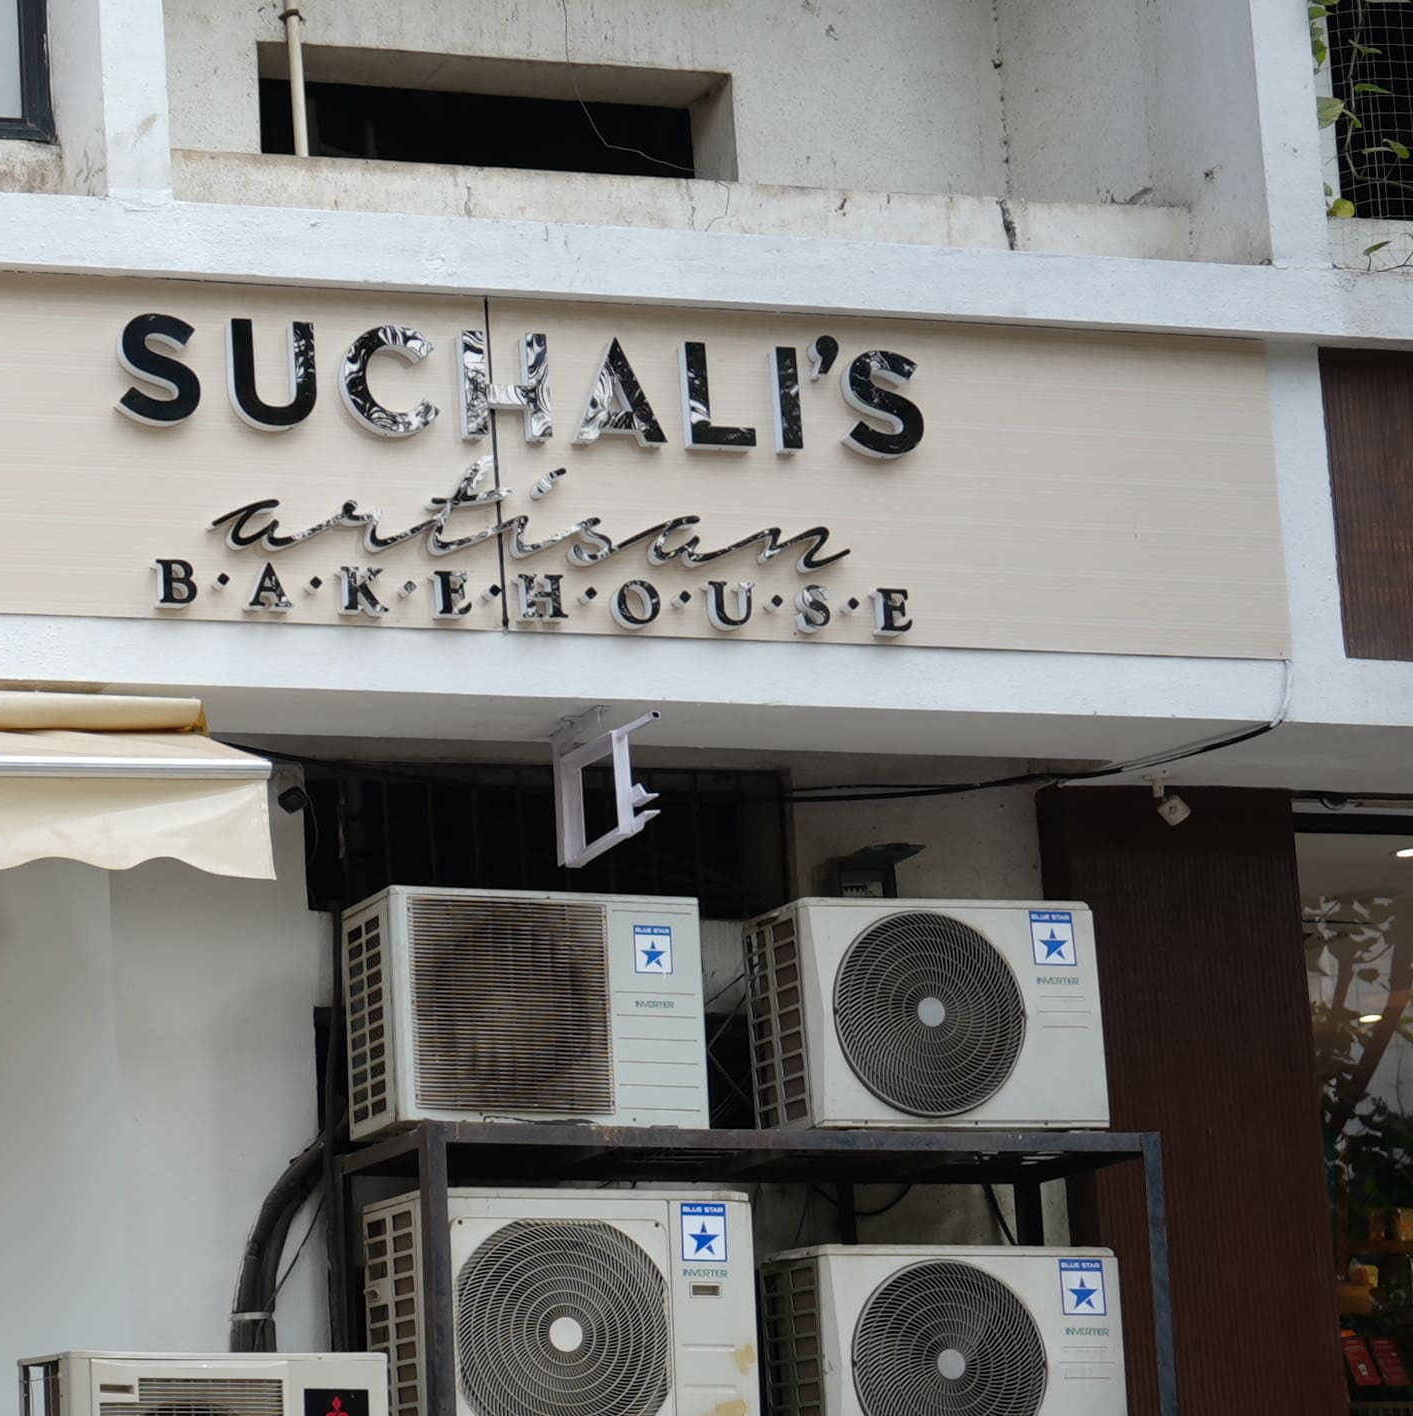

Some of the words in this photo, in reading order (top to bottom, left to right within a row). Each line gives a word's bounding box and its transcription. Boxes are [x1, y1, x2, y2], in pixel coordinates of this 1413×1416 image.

[112, 312, 926, 461] SUCHALI'S
[206, 454, 854, 575] artisan
[1036, 976, 1079, 985] INVERTER
[635, 1000, 675, 1009] INVERTER
[682, 1269, 729, 1278] INVERTER
[1065, 1327, 1110, 1337] INVERTER
